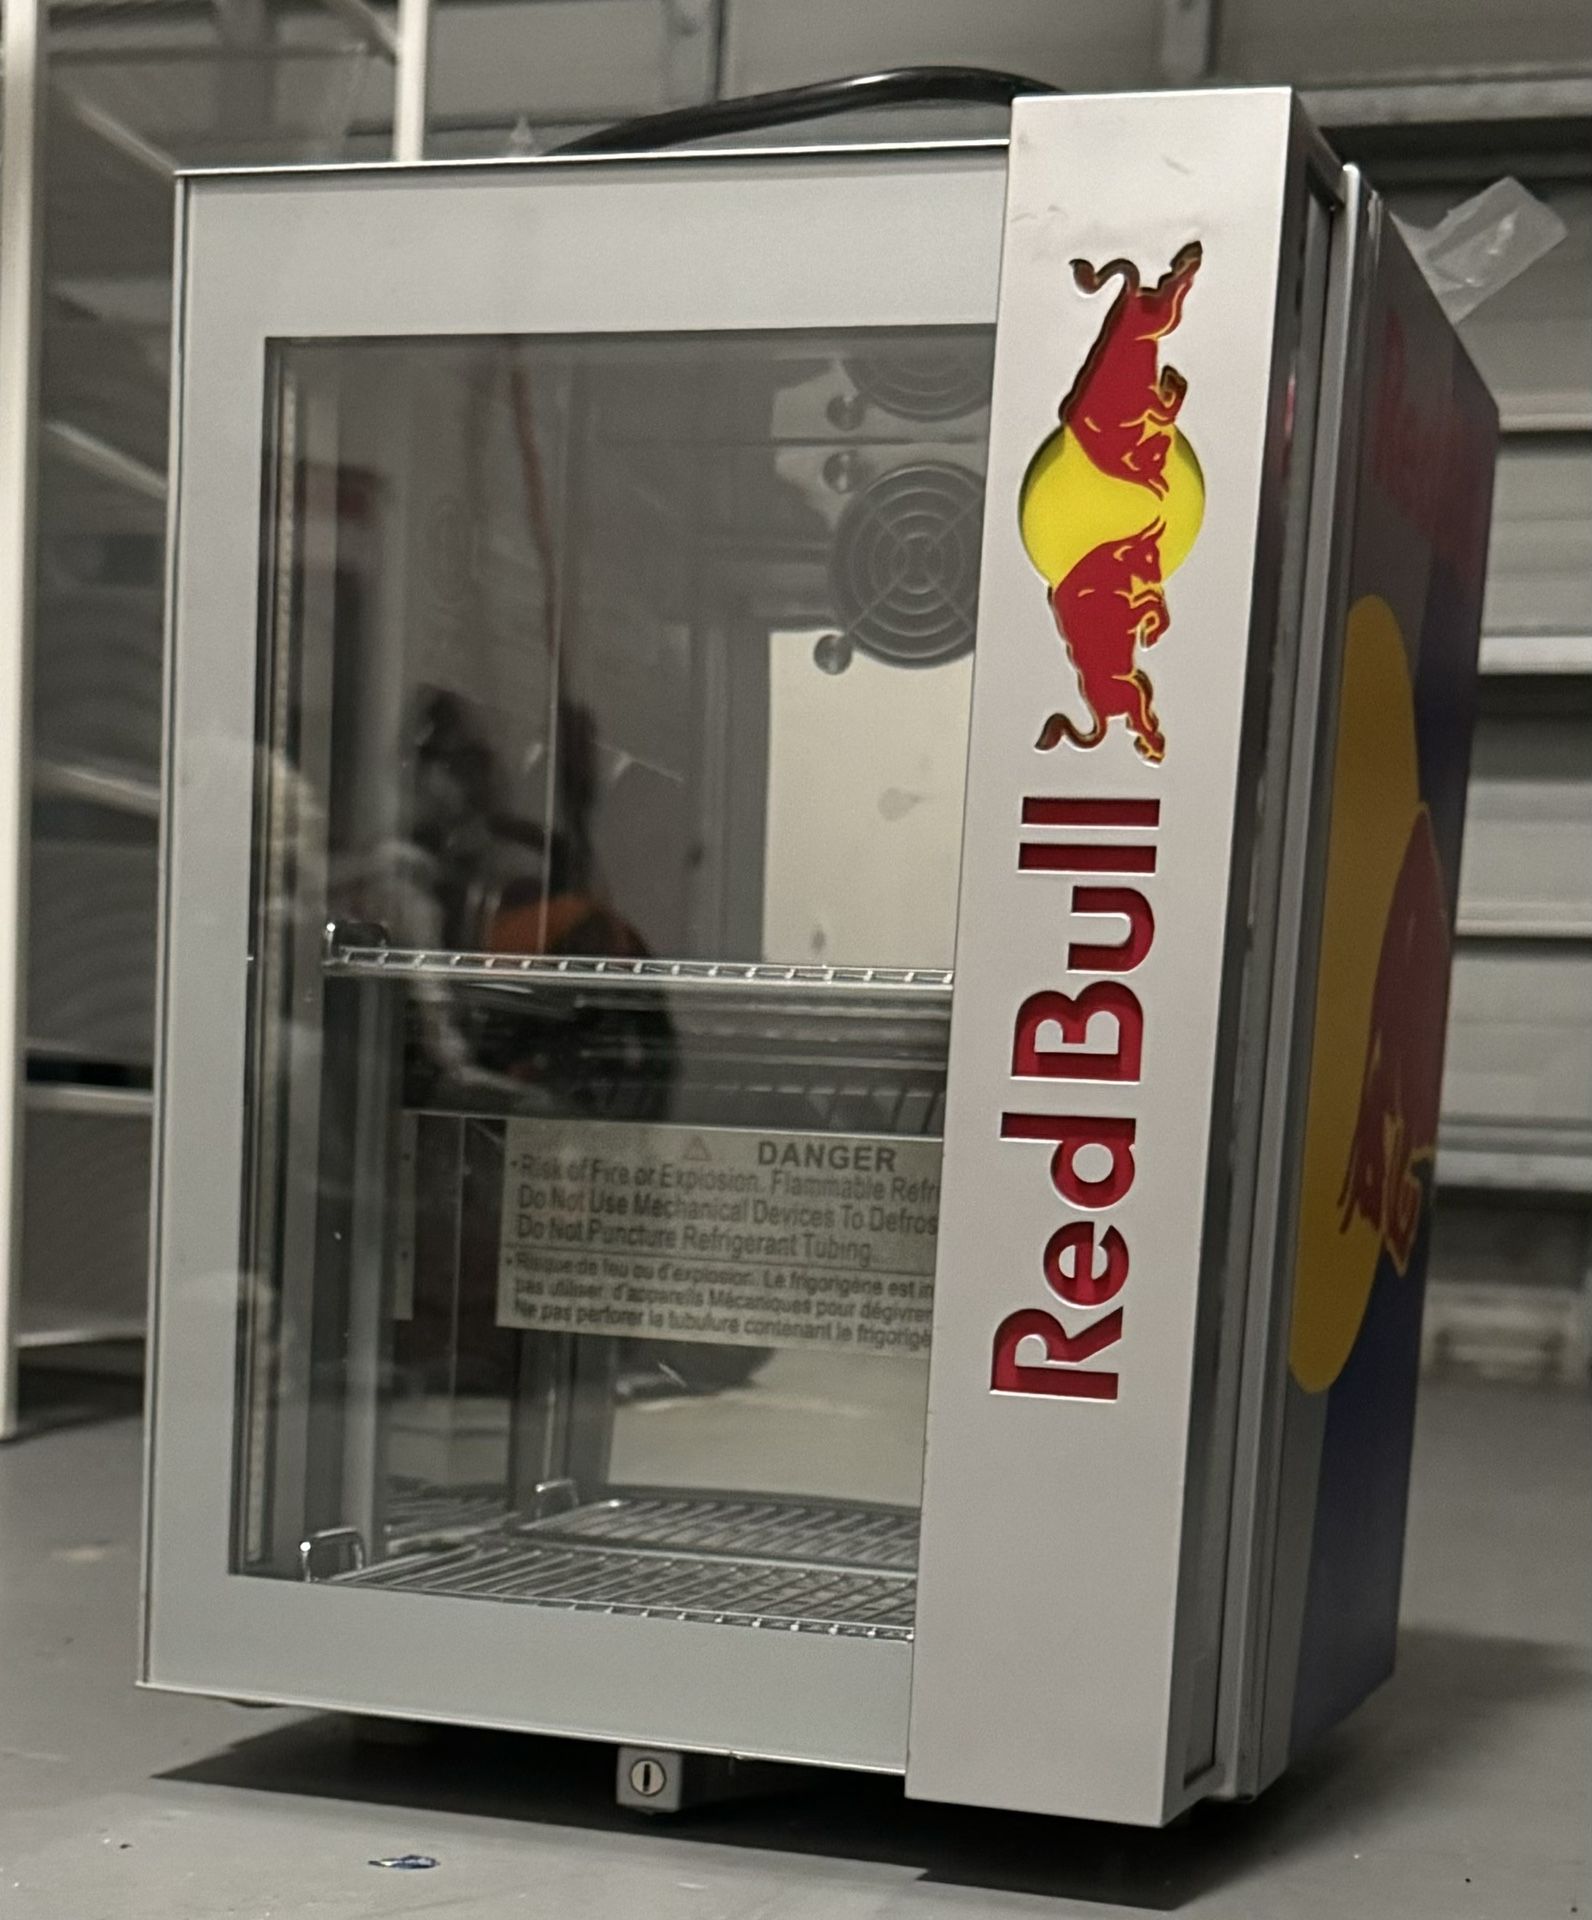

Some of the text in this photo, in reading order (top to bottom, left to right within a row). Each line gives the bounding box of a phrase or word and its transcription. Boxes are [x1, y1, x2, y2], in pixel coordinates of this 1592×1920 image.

[989, 797, 1160, 1402] Red Bull
[521, 1153, 562, 1180] Risk
[567, 1157, 588, 1181] of
[590, 1159, 629, 1185] Fire
[634, 1166, 655, 1186] or
[771, 1168, 884, 1199] Flammable
[758, 1141, 898, 1172] DANGER
[519, 1184, 545, 1210] Do
[551, 1186, 586, 1212] Not
[591, 1188, 628, 1214] Use
[633, 1192, 747, 1222] Mechanical
[753, 1199, 835, 1228] Devices
[840, 1204, 864, 1231] To
[517, 1214, 544, 1239] Do
[551, 1216, 582, 1241] Not
[588, 1218, 676, 1248] Puncture
[683, 1224, 796, 1259] Refrigerant
[763, 1269, 786, 1289] Le
[887, 1280, 915, 1298] est
[816, 1302, 855, 1321] pour
